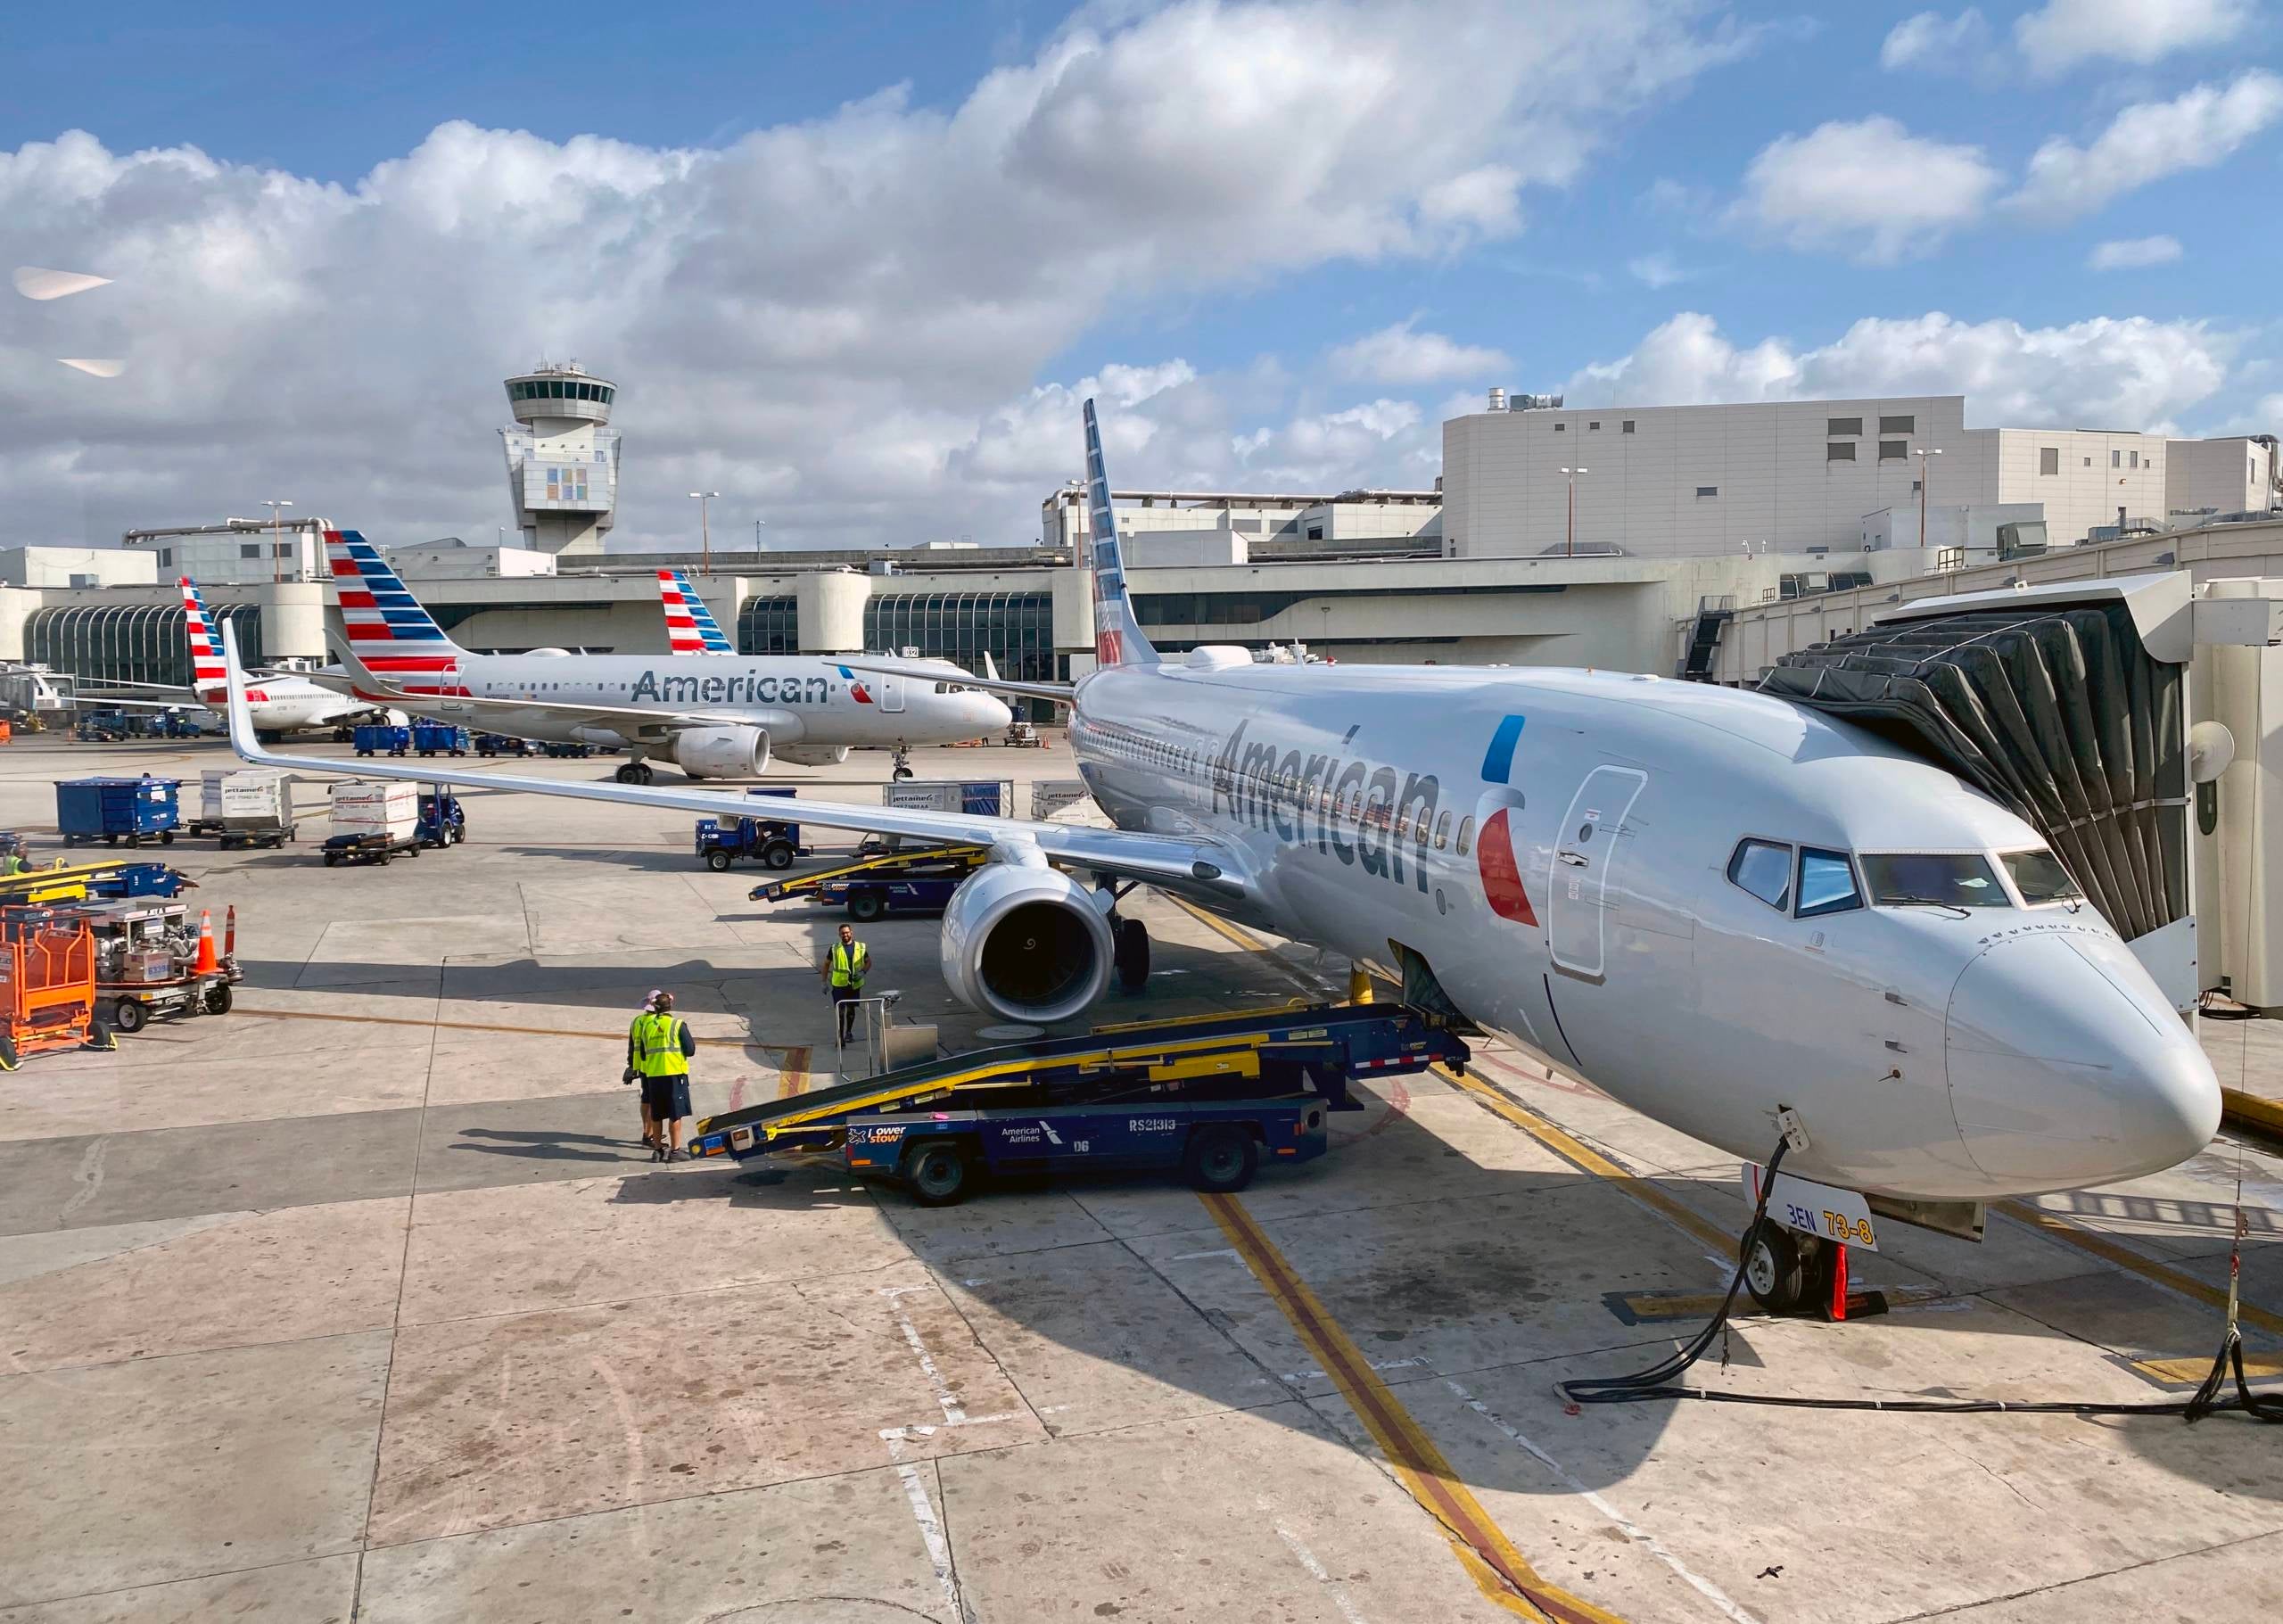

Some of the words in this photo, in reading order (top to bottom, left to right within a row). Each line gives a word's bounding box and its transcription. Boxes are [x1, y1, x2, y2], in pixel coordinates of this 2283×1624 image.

[631, 669, 827, 703] American
[1213, 719, 1439, 894] American
[1001, 1127, 1040, 1136] American
[870, 1134, 899, 1143] stow
[1009, 1135, 1040, 1143] Airlines
[1074, 1141, 1089, 1152] D6
[1786, 1204, 1817, 1232] 3EN
[1823, 1210, 1874, 1245] 73-8
